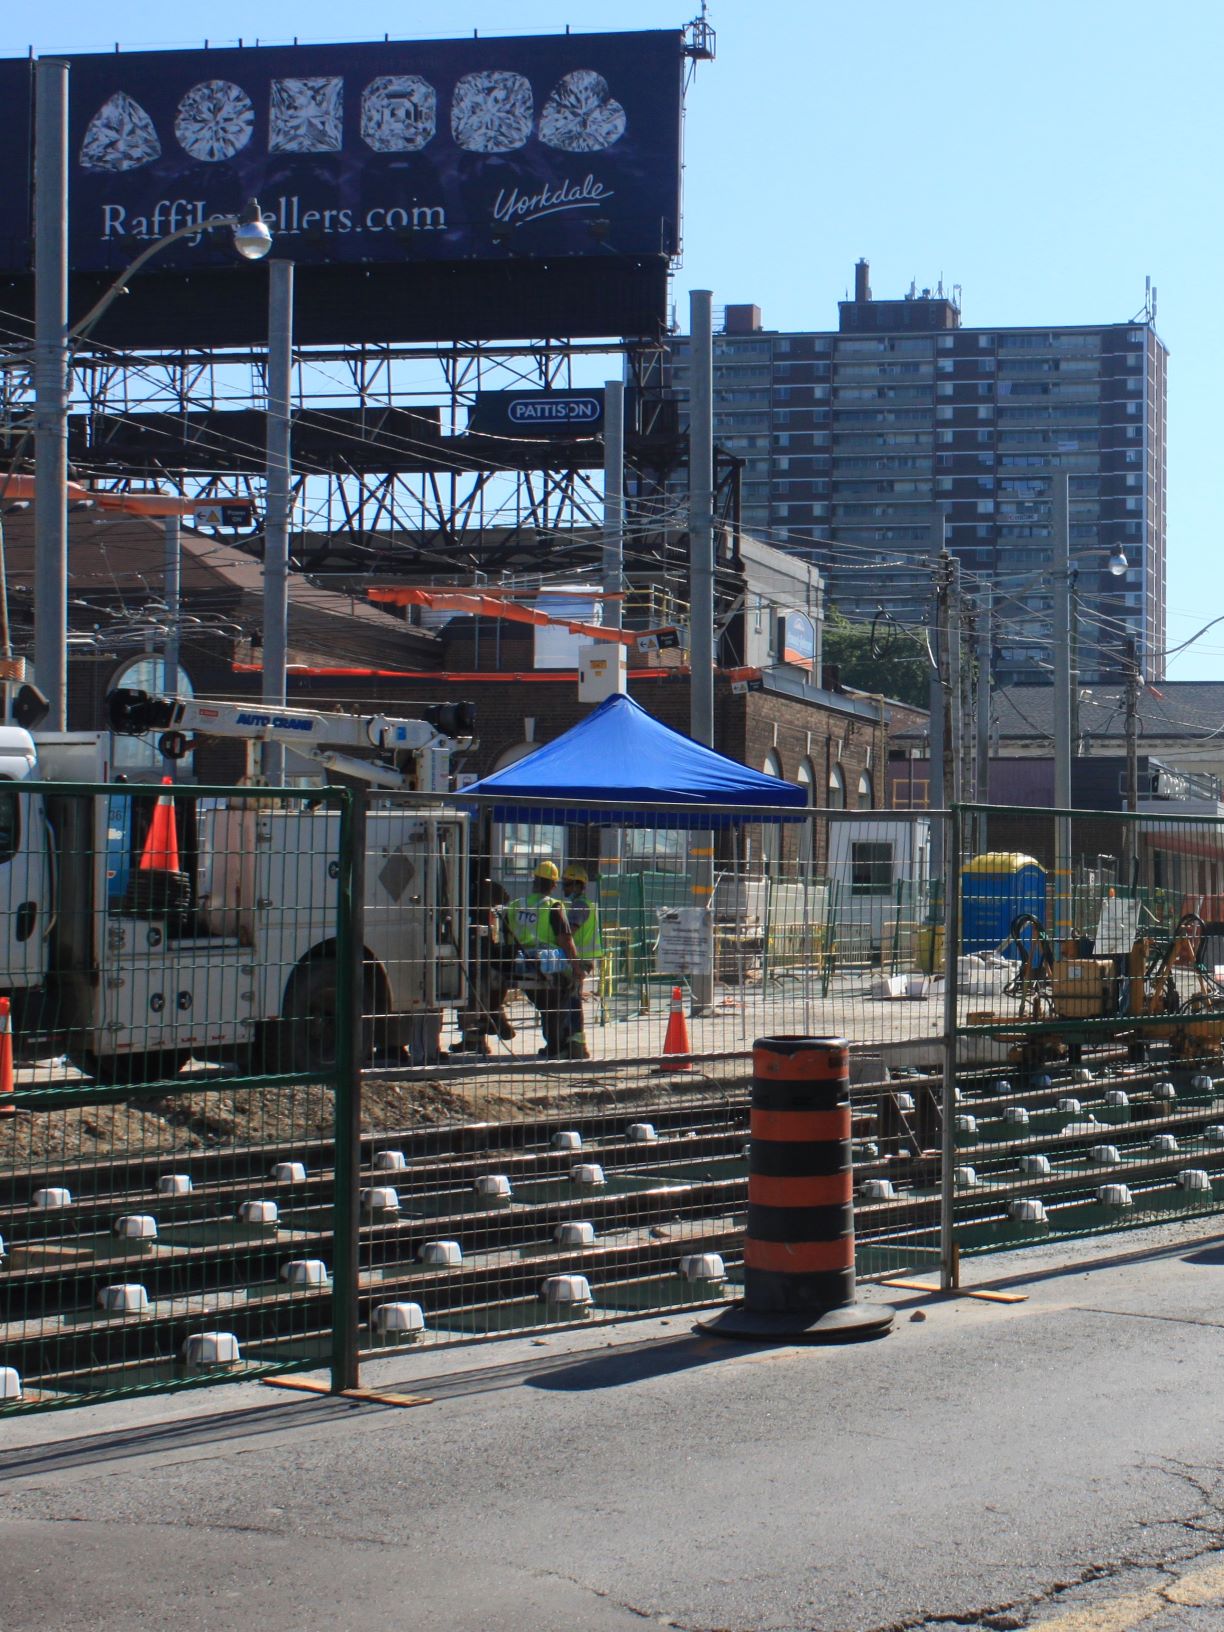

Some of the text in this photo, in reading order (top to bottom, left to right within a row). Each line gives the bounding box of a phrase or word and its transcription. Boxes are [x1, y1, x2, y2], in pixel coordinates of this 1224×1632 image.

[493, 173, 615, 223] Yorkdale
[101, 196, 448, 247] RaffiJellers.com
[516, 403, 592, 417] PATTISON
[236, 713, 270, 727] AUTO
[518, 911, 537, 923] TTC
